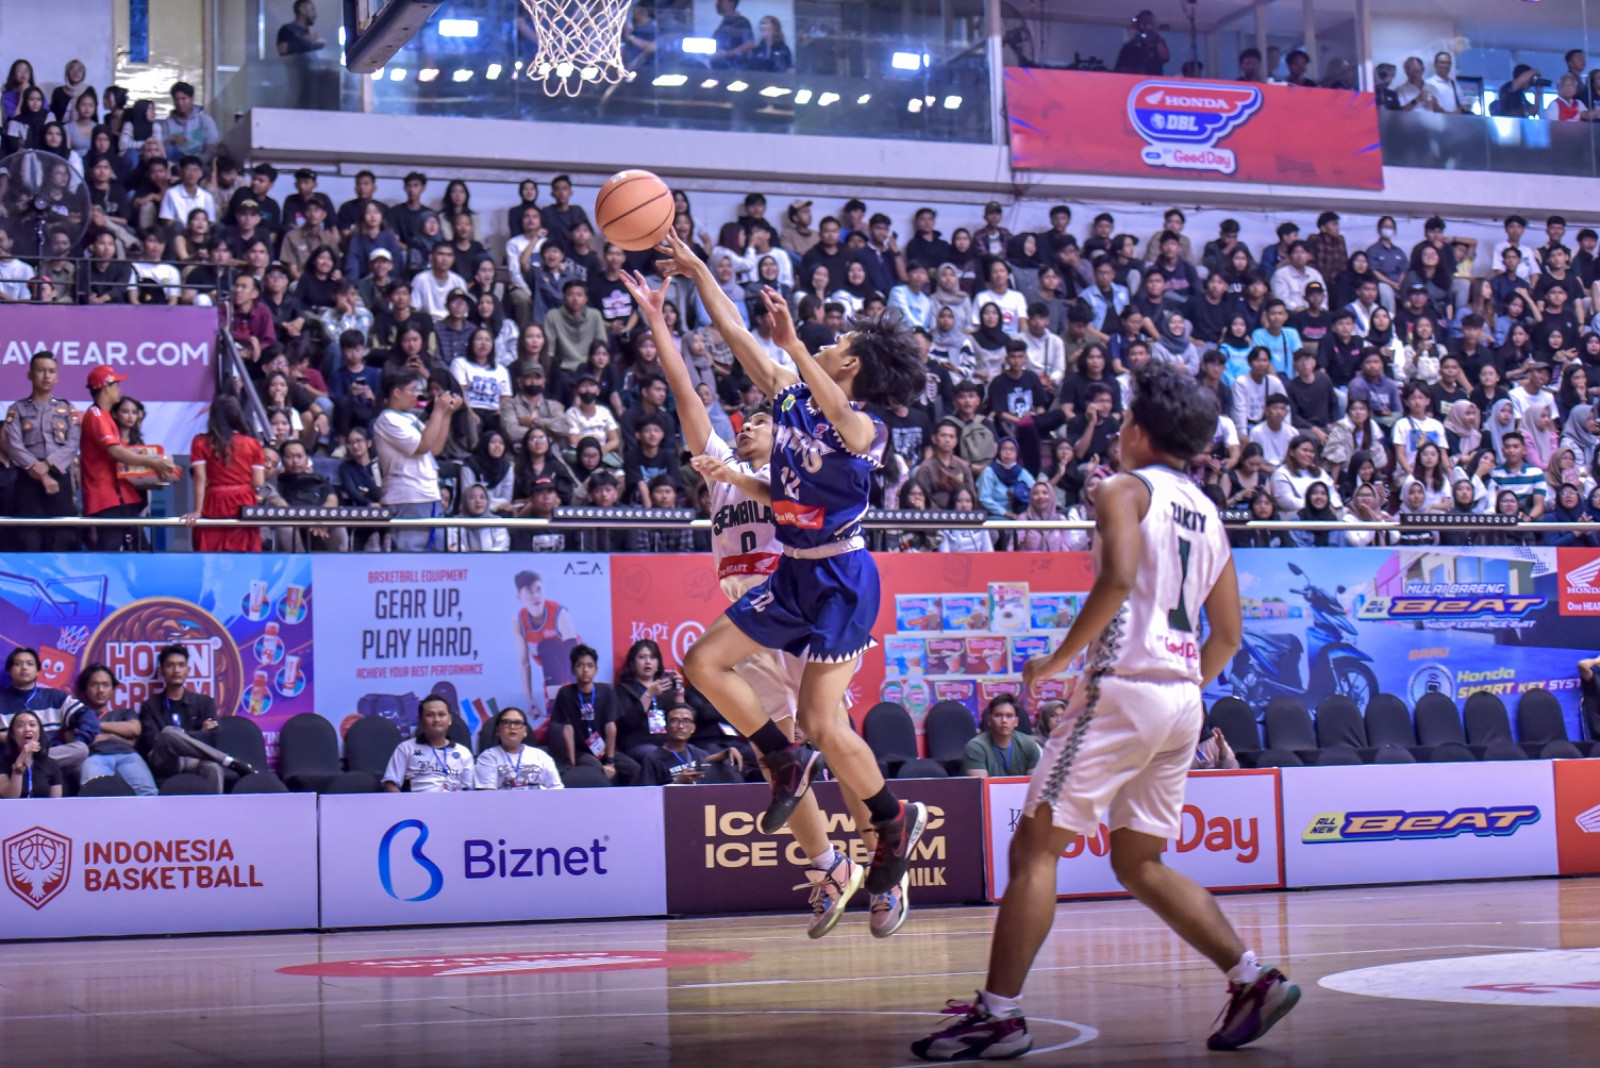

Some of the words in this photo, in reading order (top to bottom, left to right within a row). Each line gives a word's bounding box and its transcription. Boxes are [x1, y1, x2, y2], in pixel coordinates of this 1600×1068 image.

[1165, 96, 1230, 109] HONDA
[1166, 114, 1199, 131] DBL
[1207, 151, 1231, 169] Day
[0, 341, 209, 366] AWEAR.COM
[713, 500, 777, 536] SEMBILA
[740, 531, 757, 553] 0
[368, 570, 419, 584] BASKETBALL
[421, 568, 468, 583] EQUIPMENT
[1168, 536, 1193, 633] 1
[1405, 584, 1445, 594] MULAI
[1449, 583, 1507, 594] BARENG
[1566, 586, 1600, 594] HOND
[375, 589, 426, 619] GEAR
[433, 588, 463, 622] UP,
[1583, 602, 1600, 611] HEA
[362, 628, 411, 660] PLAY
[418, 626, 479, 660] HARD,
[356, 666, 387, 680] ACHIEVE
[389, 666, 409, 678] YOUR
[411, 665, 429, 678] BEST
[430, 663, 484, 677] PERFORMANCE
[1457, 667, 1516, 683] Honda
[1548, 678, 1582, 691] SYST
[1310, 825, 1338, 835] NEW
[1315, 817, 1336, 826] ALL
[1343, 810, 1536, 834] BeAT
[1176, 804, 1259, 863] Day
[84, 838, 235, 865] INDONESIA
[464, 838, 608, 880] Biznet
[705, 841, 779, 868] ICE
[785, 835, 947, 867] CREM
[84, 864, 264, 892] BASKETBALL
